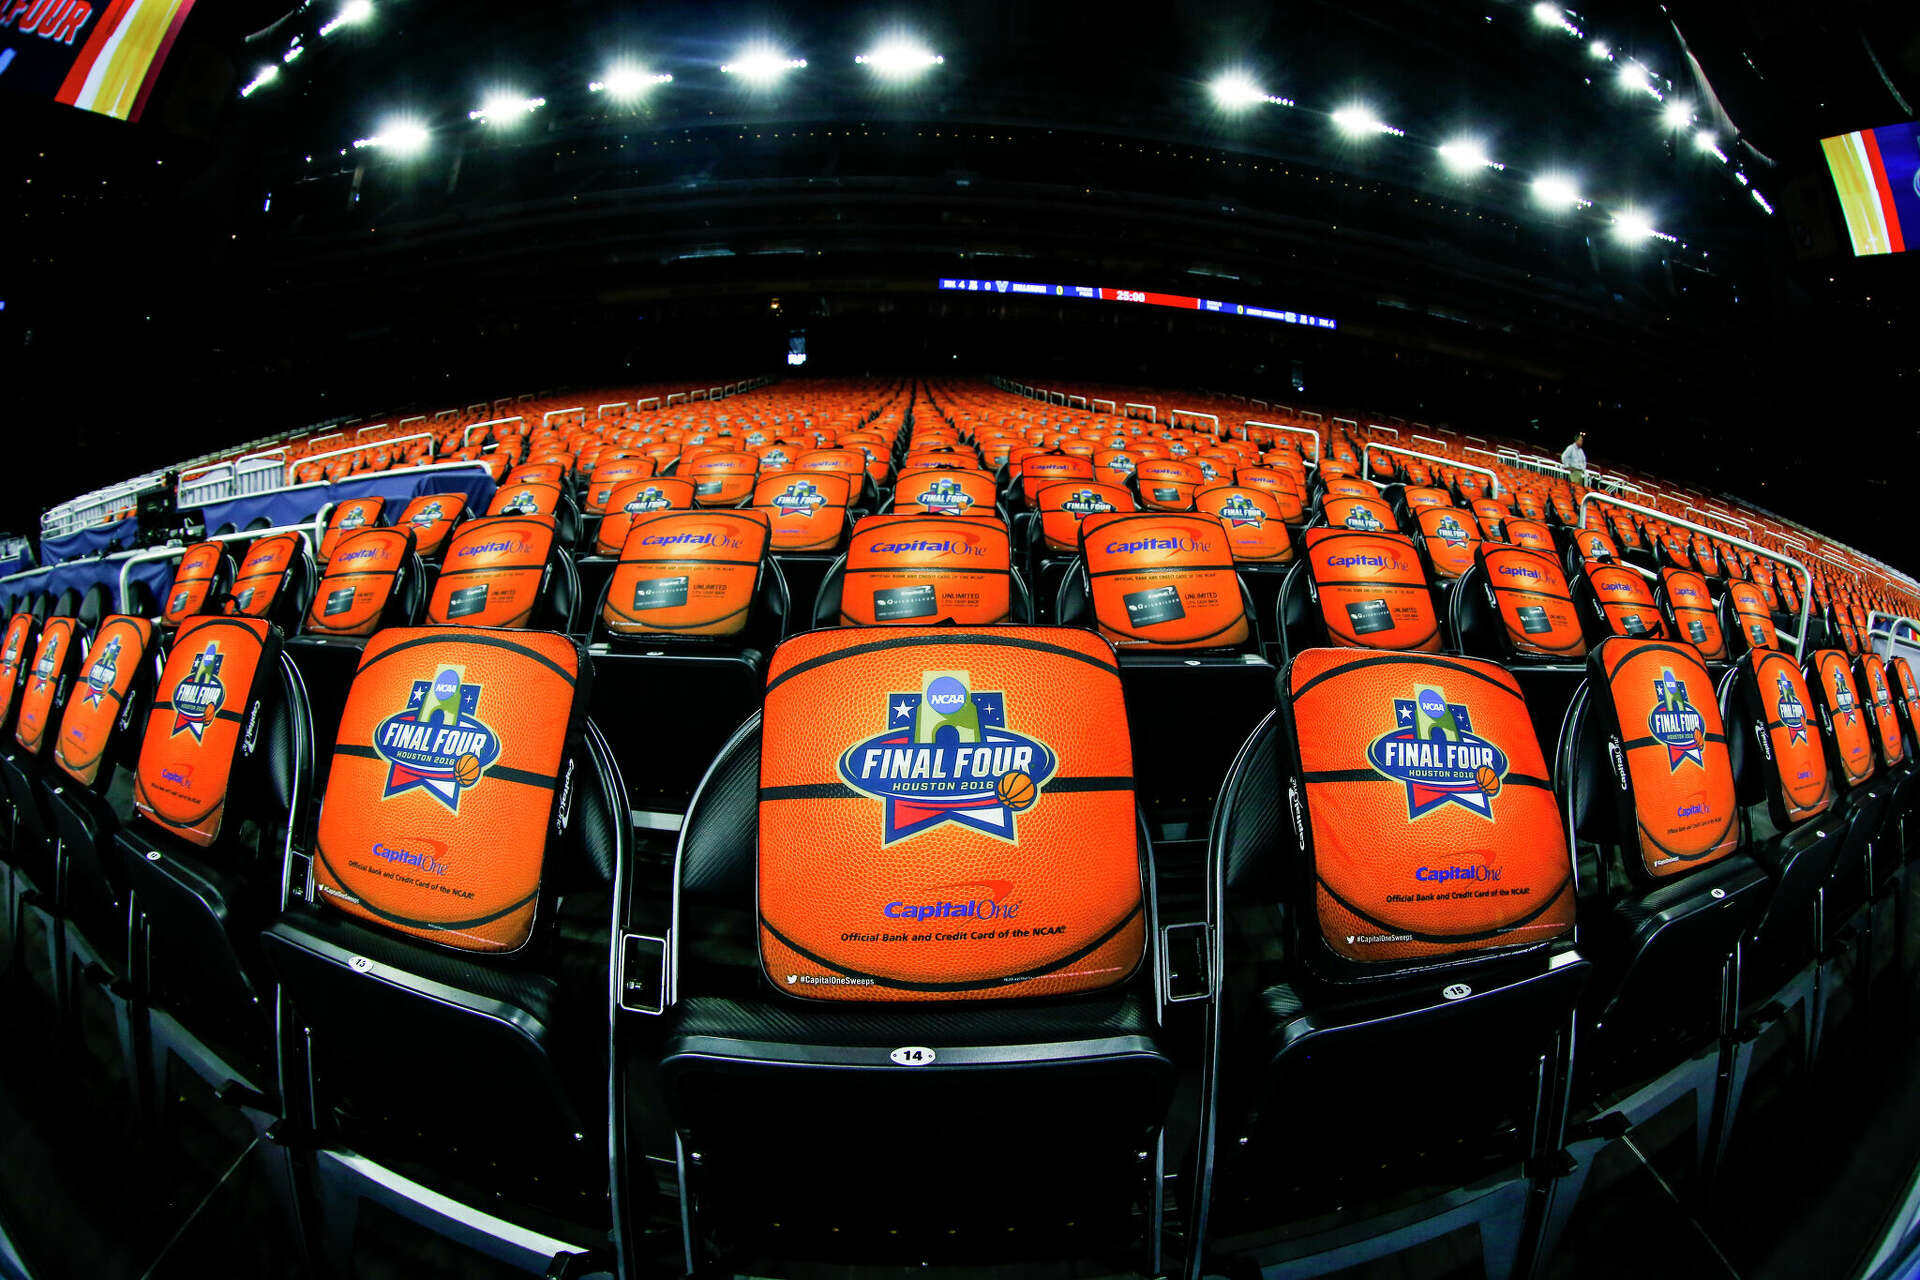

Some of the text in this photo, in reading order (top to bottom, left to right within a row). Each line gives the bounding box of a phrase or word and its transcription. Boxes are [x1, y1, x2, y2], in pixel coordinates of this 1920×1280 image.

[1116, 290, 1146, 302] 25:00
[922, 494, 944, 503] FINAL
[1066, 502, 1088, 510] FINAL
[869, 540, 986, 556] CapitalOne
[1105, 537, 1212, 554] CapitalOne
[931, 694, 965, 704] NCAA
[1422, 702, 1445, 712] NCAA
[1655, 713, 1680, 733] FINAL
[383, 723, 487, 758] FINAL FOUR
[396, 751, 432, 762] HOUSTON
[1385, 742, 1494, 769] FINAL FOUR
[861, 746, 1034, 779] FINAL FOUR
[1408, 769, 1451, 777] HOUSTON
[892, 781, 994, 791] HOUSTON 2016
[1415, 864, 1501, 883] CapitalOne
[1386, 895, 1414, 903] Official
[1416, 893, 1434, 902] Bank
[1474, 890, 1489, 898] Card
[1491, 889, 1498, 897] of
[883, 899, 1019, 922] CapitalOne
[841, 933, 879, 942] Official
[882, 933, 908, 942] Bank
[911, 933, 932, 941] and
[935, 932, 967, 941] Credit
[970, 930, 995, 940] Card
[998, 929, 1009, 939] of
[1012, 928, 1030, 938] the
[1357, 934, 1413, 943] #CapitalOneSweeps
[800, 975, 875, 987] #CapitalOneSweeps
[1450, 986, 1464, 995] 15
[903, 1051, 923, 1061] 14
